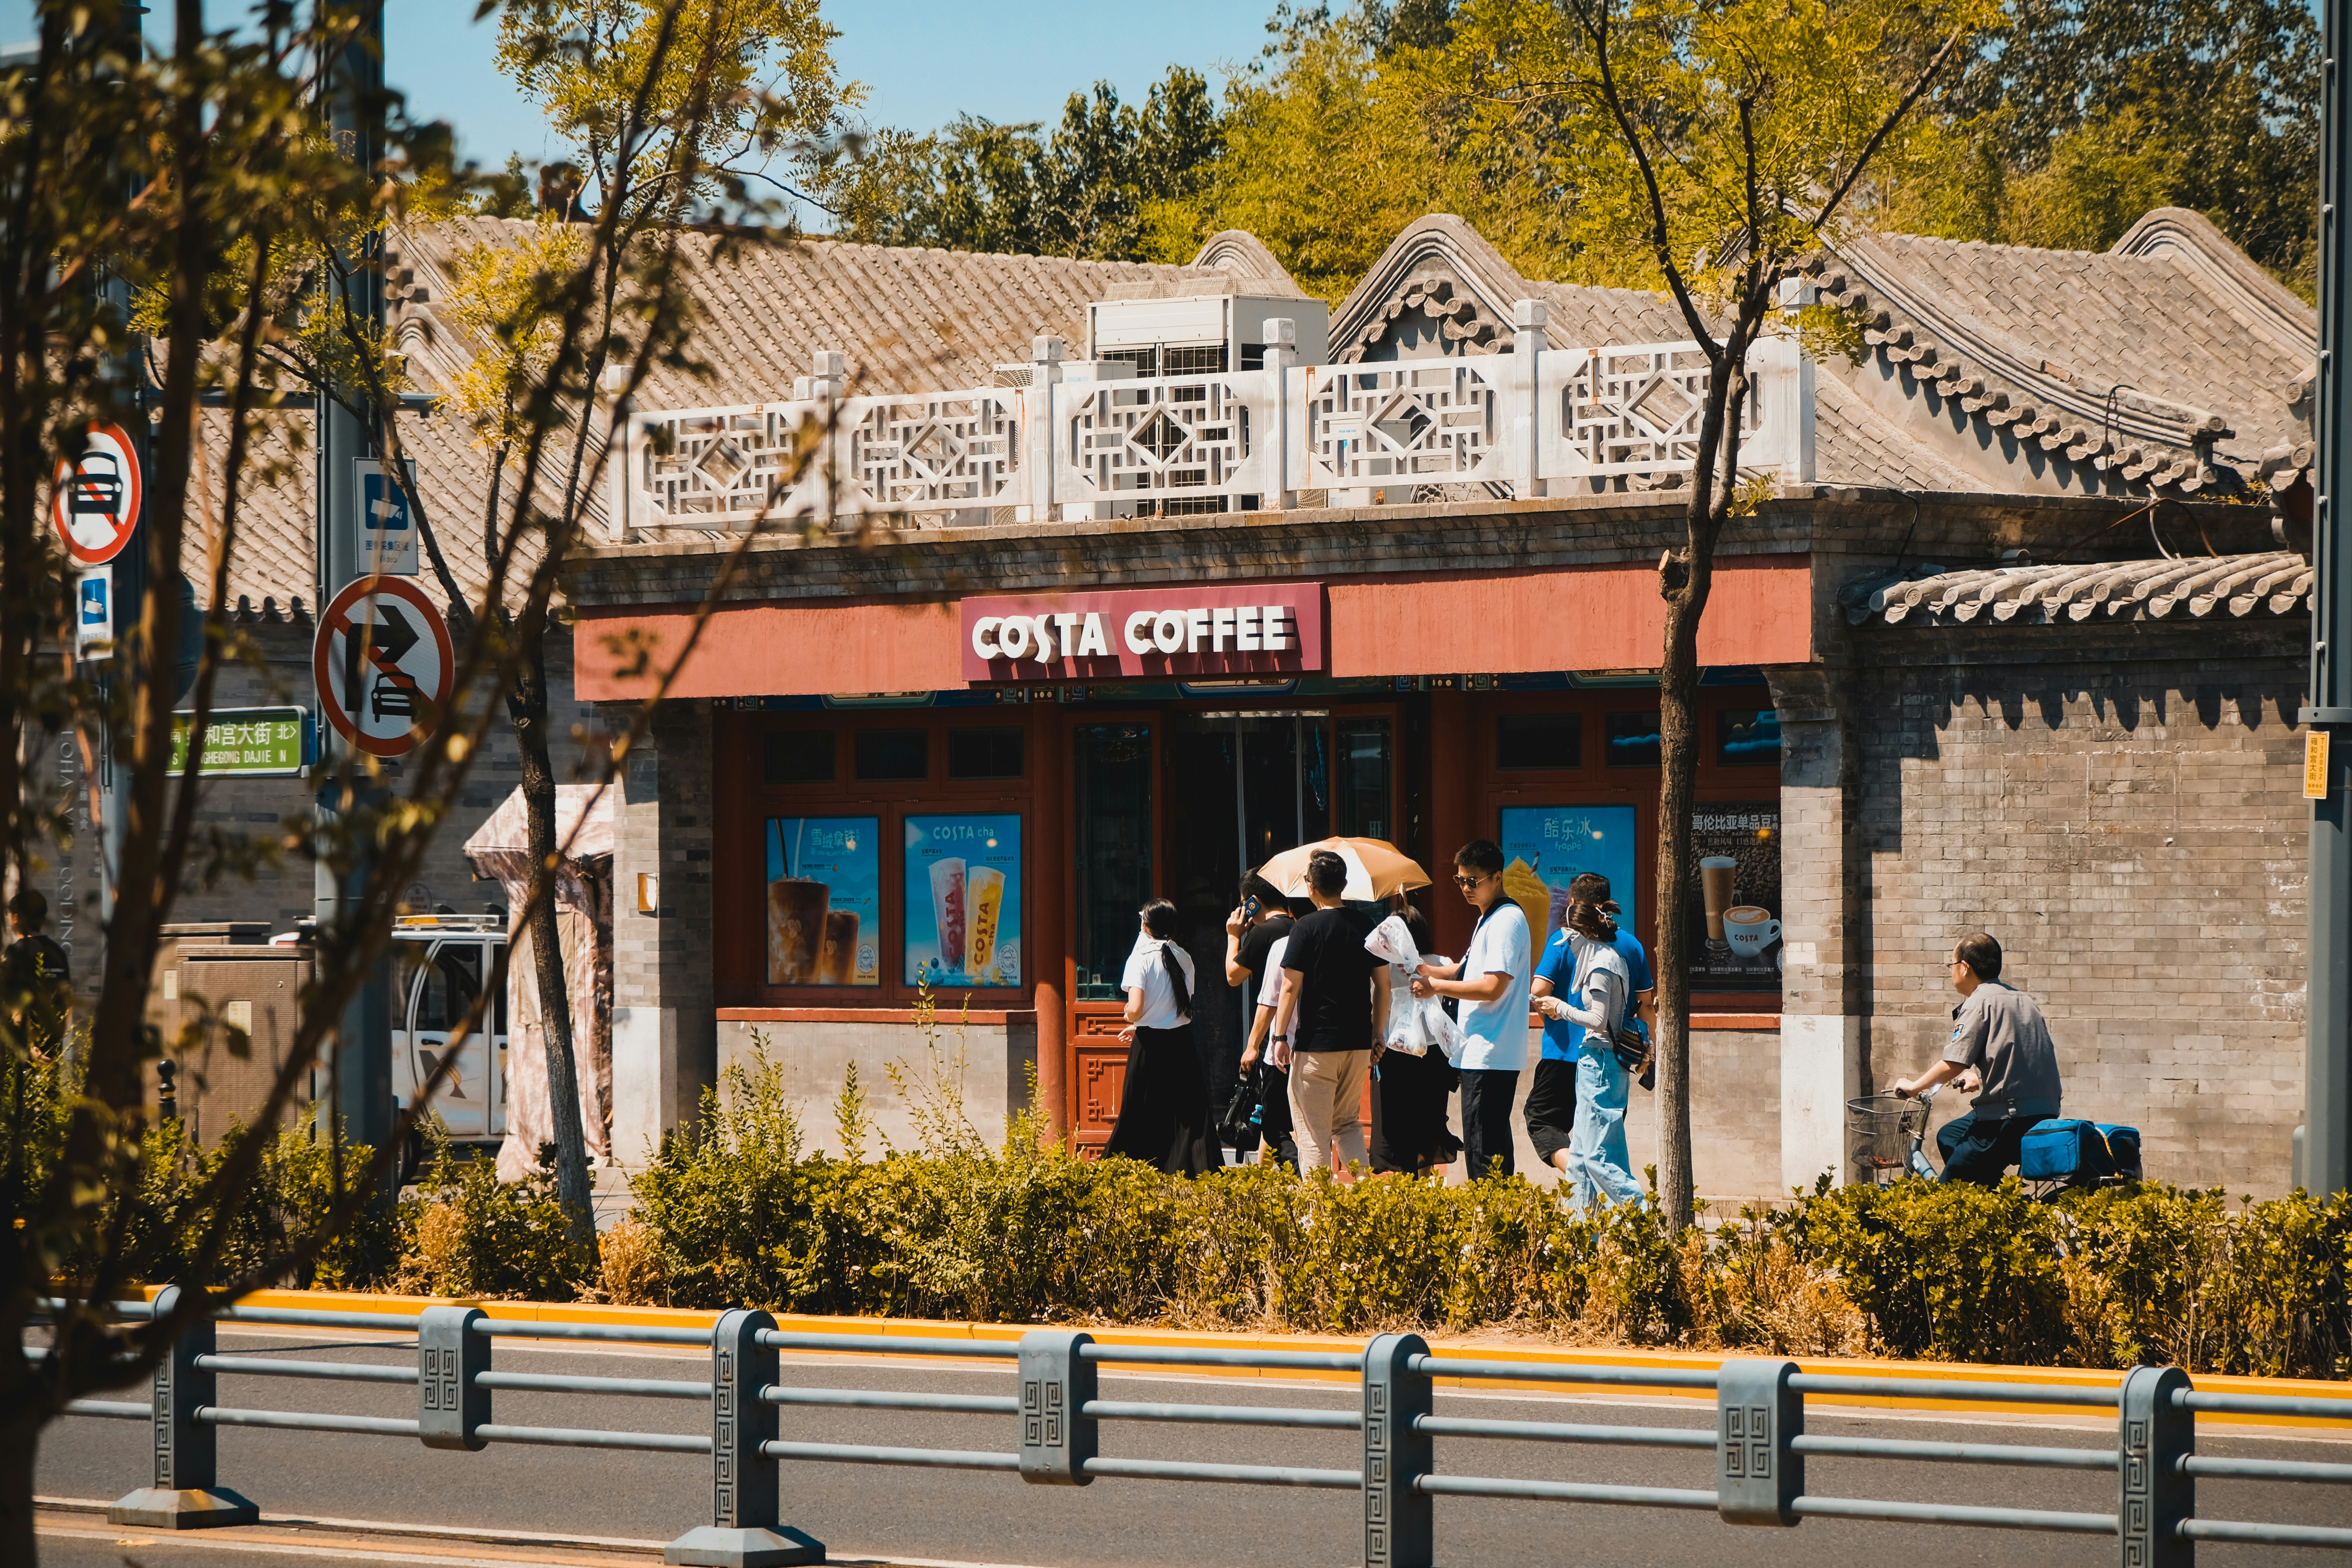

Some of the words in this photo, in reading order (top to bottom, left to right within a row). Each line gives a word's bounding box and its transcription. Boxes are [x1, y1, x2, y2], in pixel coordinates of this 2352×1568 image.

[379, 555, 397, 563] Video
[972, 612, 1113, 664] COSTA
[1125, 606, 1292, 655] COFFEE
[187, 722, 271, 746] 和宫大街
[277, 728, 289, 740] 北
[172, 752, 178, 765] S
[196, 750, 240, 764] GHEGONG
[245, 750, 271, 763] DAJIE
[280, 750, 287, 762] N
[2309, 737, 2318, 780] 雍和宫大街
[1544, 816, 1592, 841] 酷乐冰
[1692, 815, 1771, 830] 哥伦比亚单品豆
[811, 828, 855, 849] 雪绒拿铁
[933, 826, 975, 842] COSTA
[977, 826, 994, 837] cha
[1708, 837, 1733, 846] 焦糖风味
[1737, 837, 1762, 846] 口感饱满
[1555, 840, 1582, 852] frappé
[945, 891, 958, 958] COSTA
[974, 902, 989, 965] COSTA
[1734, 934, 1758, 942] COSTA
